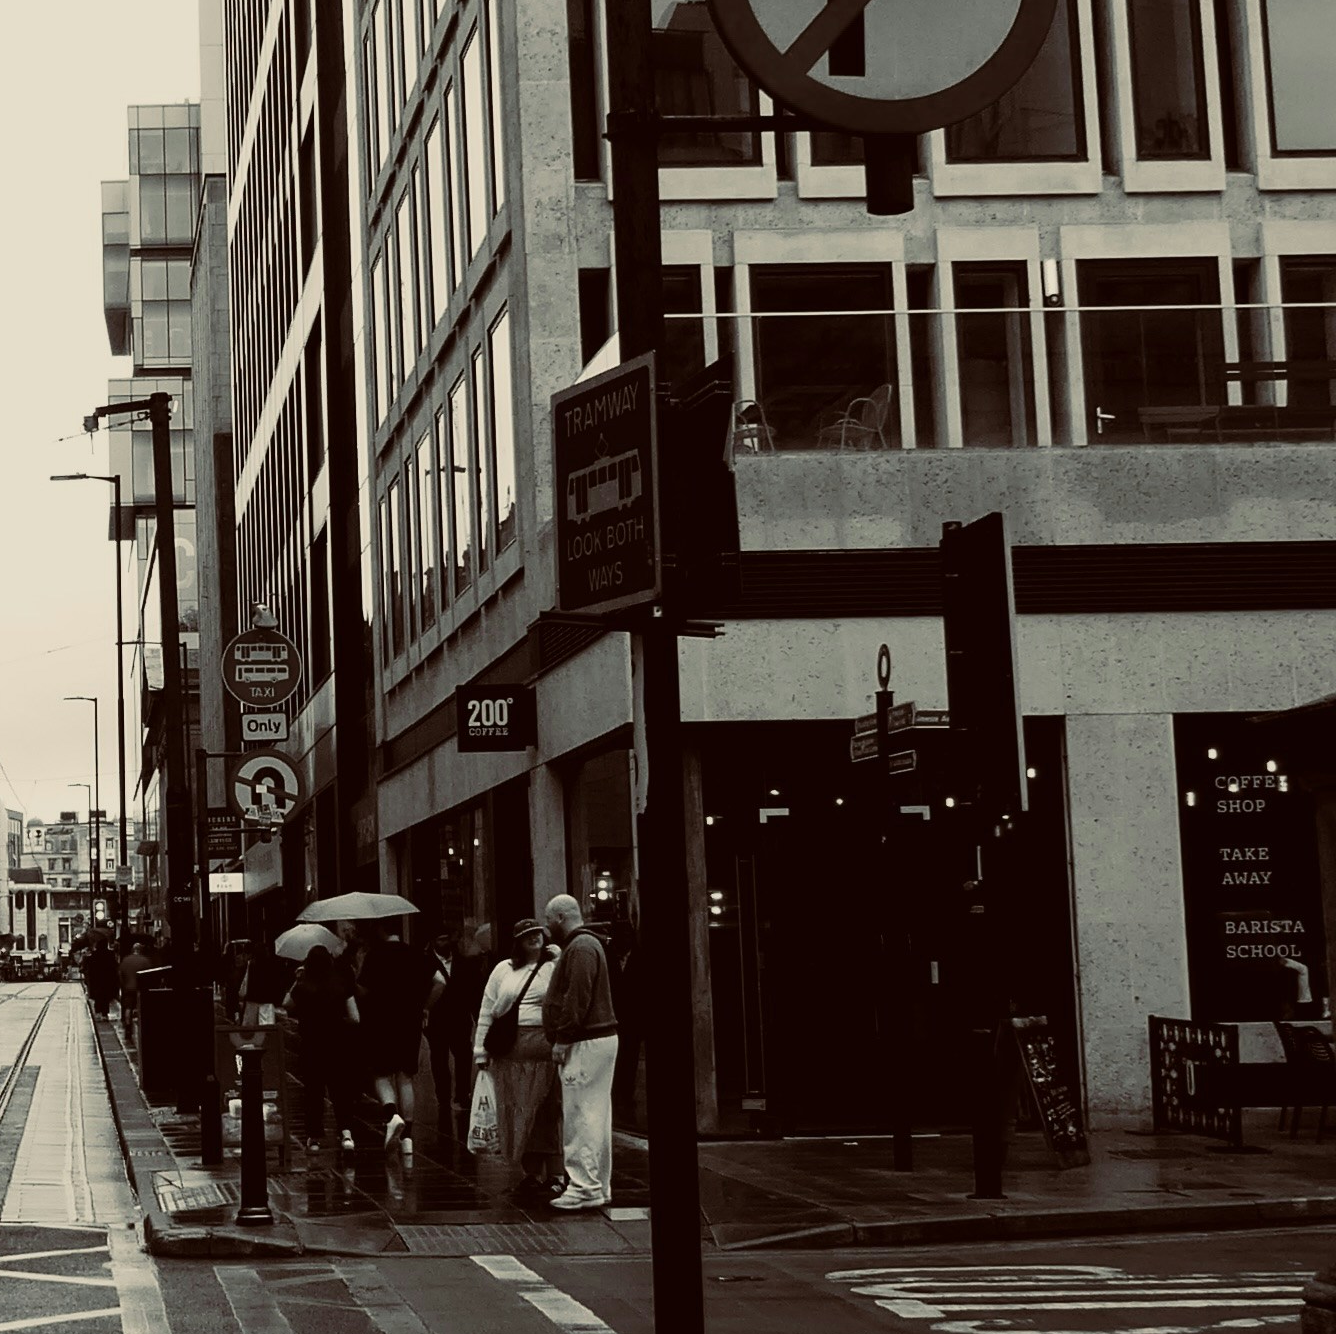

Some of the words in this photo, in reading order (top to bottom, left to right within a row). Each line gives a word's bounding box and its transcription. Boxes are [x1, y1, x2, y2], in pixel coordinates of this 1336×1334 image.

[564, 380, 639, 438] TRAMWAY
[567, 531, 603, 562] LOOK
[606, 516, 645, 550] BOTH
[588, 561, 623, 592] WAYS
[249, 686, 275, 698] TAXI
[247, 718, 281, 734] Only
[468, 727, 509, 737] COFFEE
[1217, 799, 1266, 813] SHOP
[1219, 847, 1270, 861] TAKE
[1221, 871, 1273, 886] AWAY
[1225, 920, 1305, 934] BARISTA
[1226, 944, 1302, 959] SCHOOL
